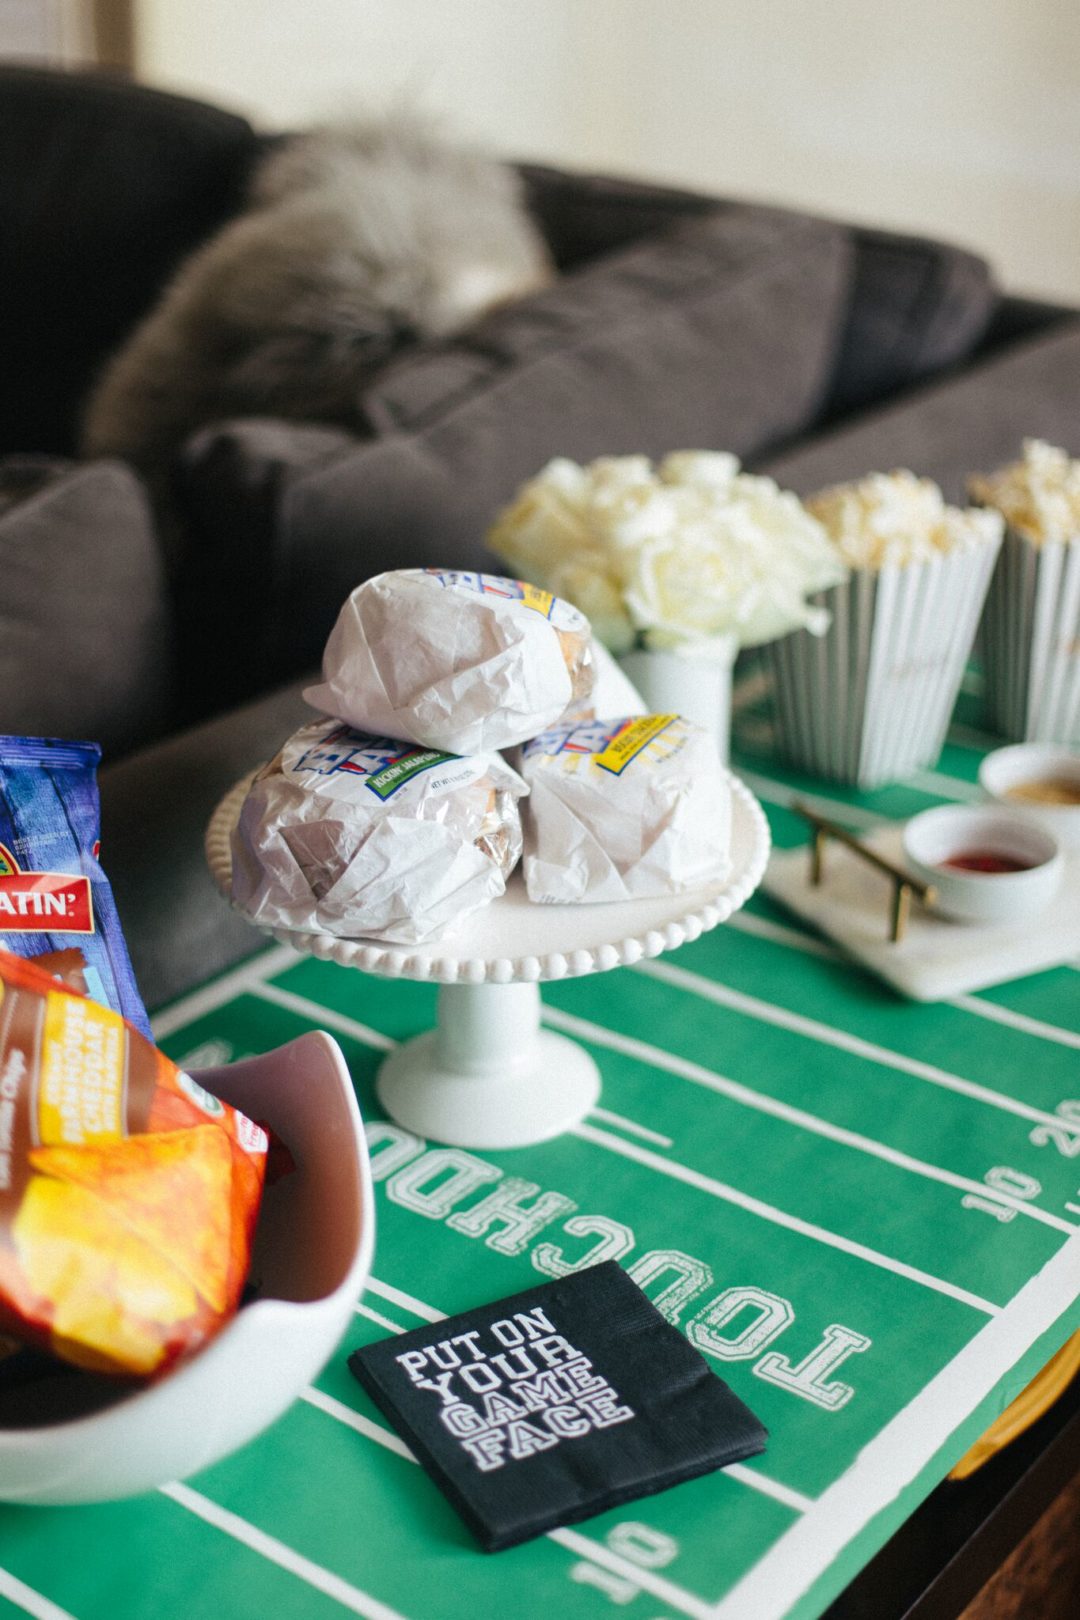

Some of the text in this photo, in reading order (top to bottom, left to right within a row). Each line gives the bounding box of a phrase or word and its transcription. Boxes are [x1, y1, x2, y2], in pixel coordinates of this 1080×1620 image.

[961, 1166, 1042, 1223] 10
[364, 1120, 873, 1412] TOUCHDO
[395, 1307, 557, 1382] PUT ON
[415, 1334, 584, 1406] YOUR
[440, 1356, 609, 1438] GAME
[461, 1387, 636, 1473] FACE
[570, 1521, 679, 1605] 10
